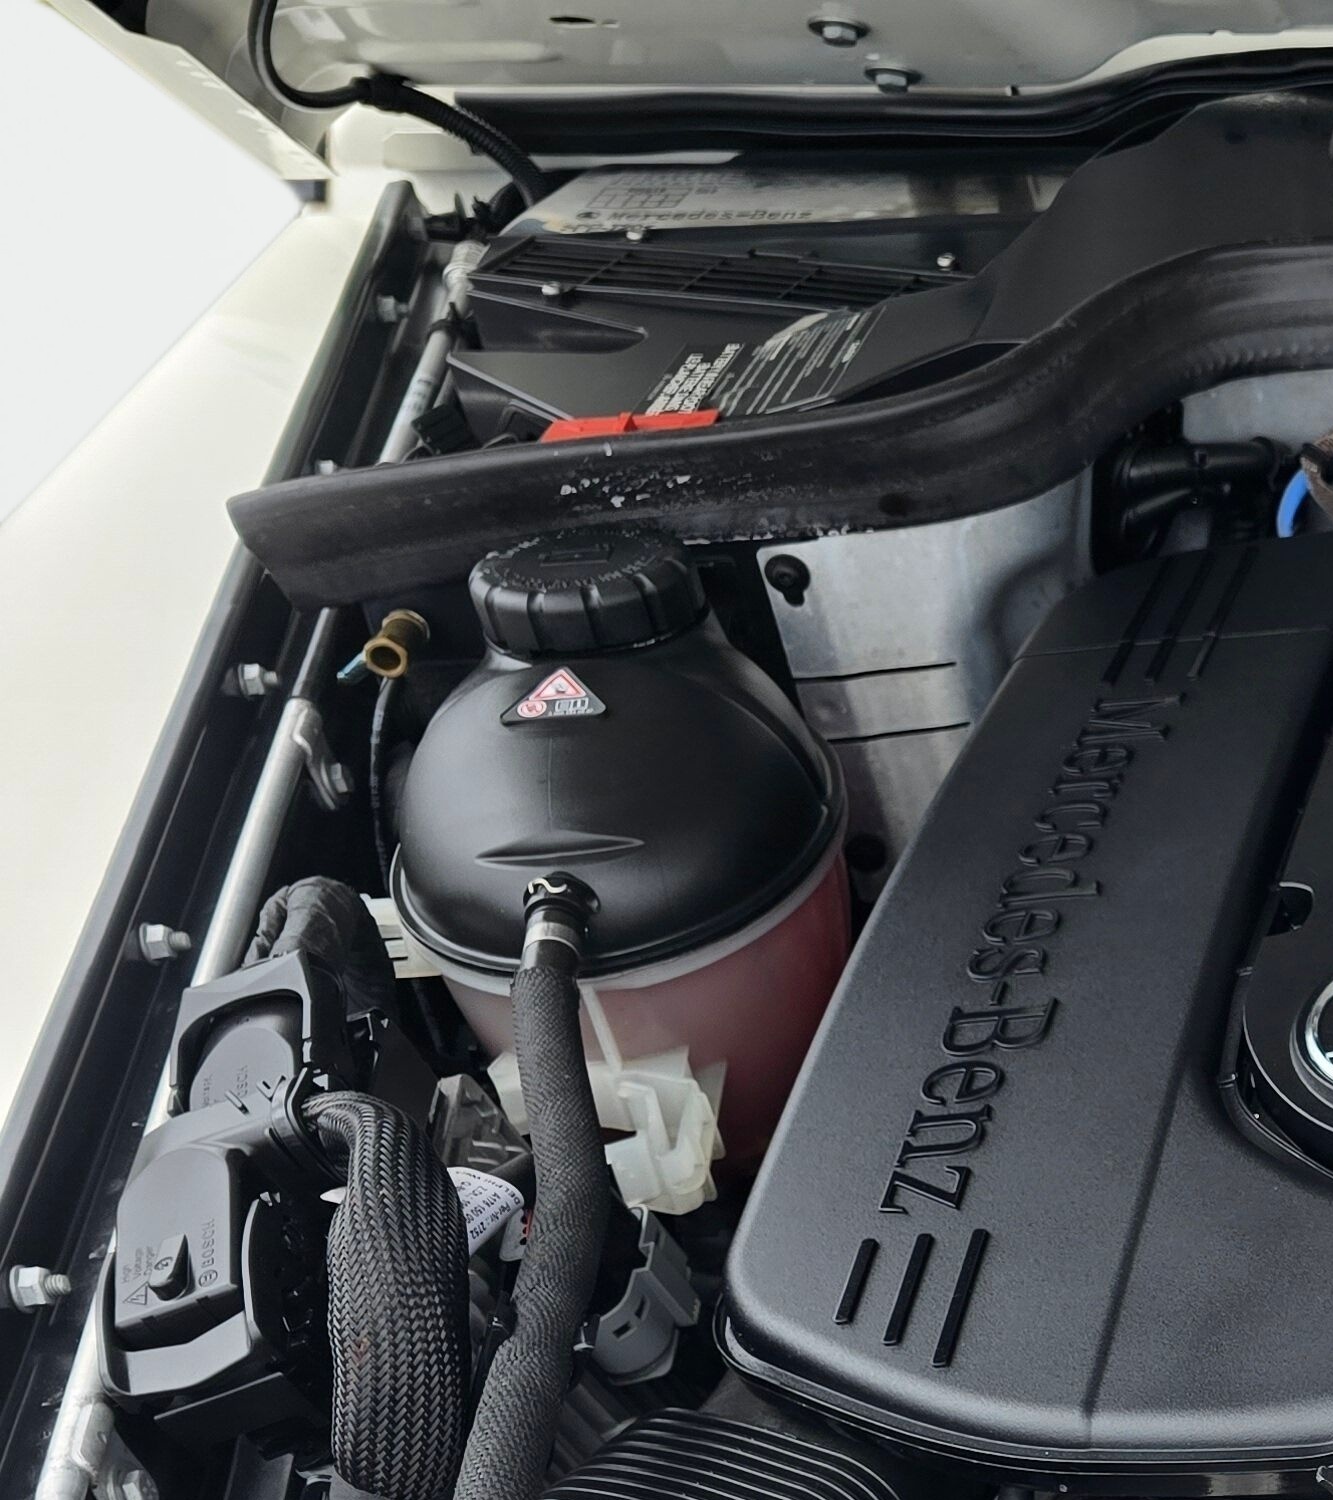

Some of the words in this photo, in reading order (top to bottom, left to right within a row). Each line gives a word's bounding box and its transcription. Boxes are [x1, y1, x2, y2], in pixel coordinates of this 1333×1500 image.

[606, 209, 813, 222] Mercedes-Benz
[876, 691, 1187, 1214] Mercedes-Benz
[201, 1216, 215, 1269] BOSCH
